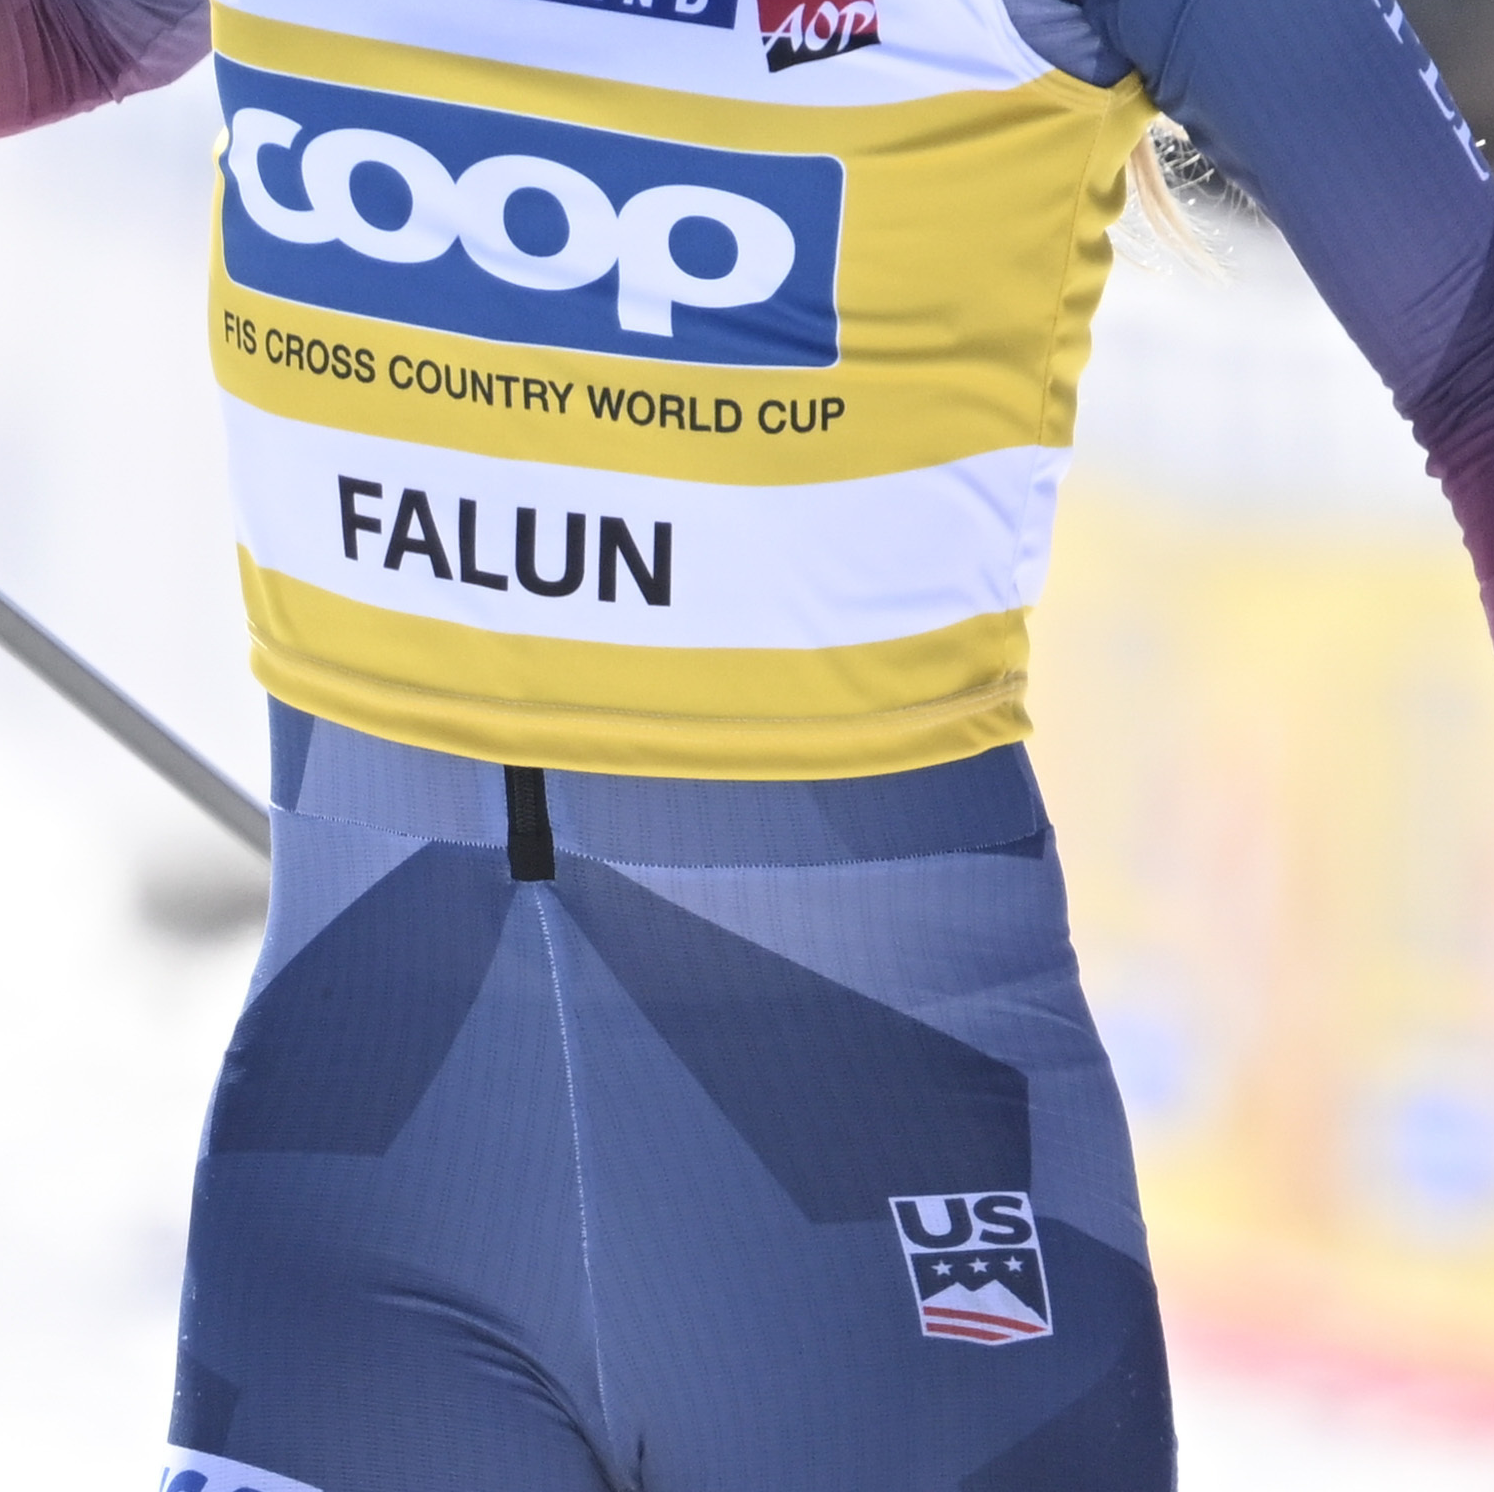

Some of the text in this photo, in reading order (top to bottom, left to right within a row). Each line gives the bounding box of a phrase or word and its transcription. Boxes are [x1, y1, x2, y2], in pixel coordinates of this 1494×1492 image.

[761, 0, 877, 53] AOP
[227, 107, 796, 339] coop
[223, 309, 847, 436] FIS CROSS COUNTRY WORLD CUP
[337, 473, 674, 608] FALUN
[894, 1194, 1034, 1250] US
